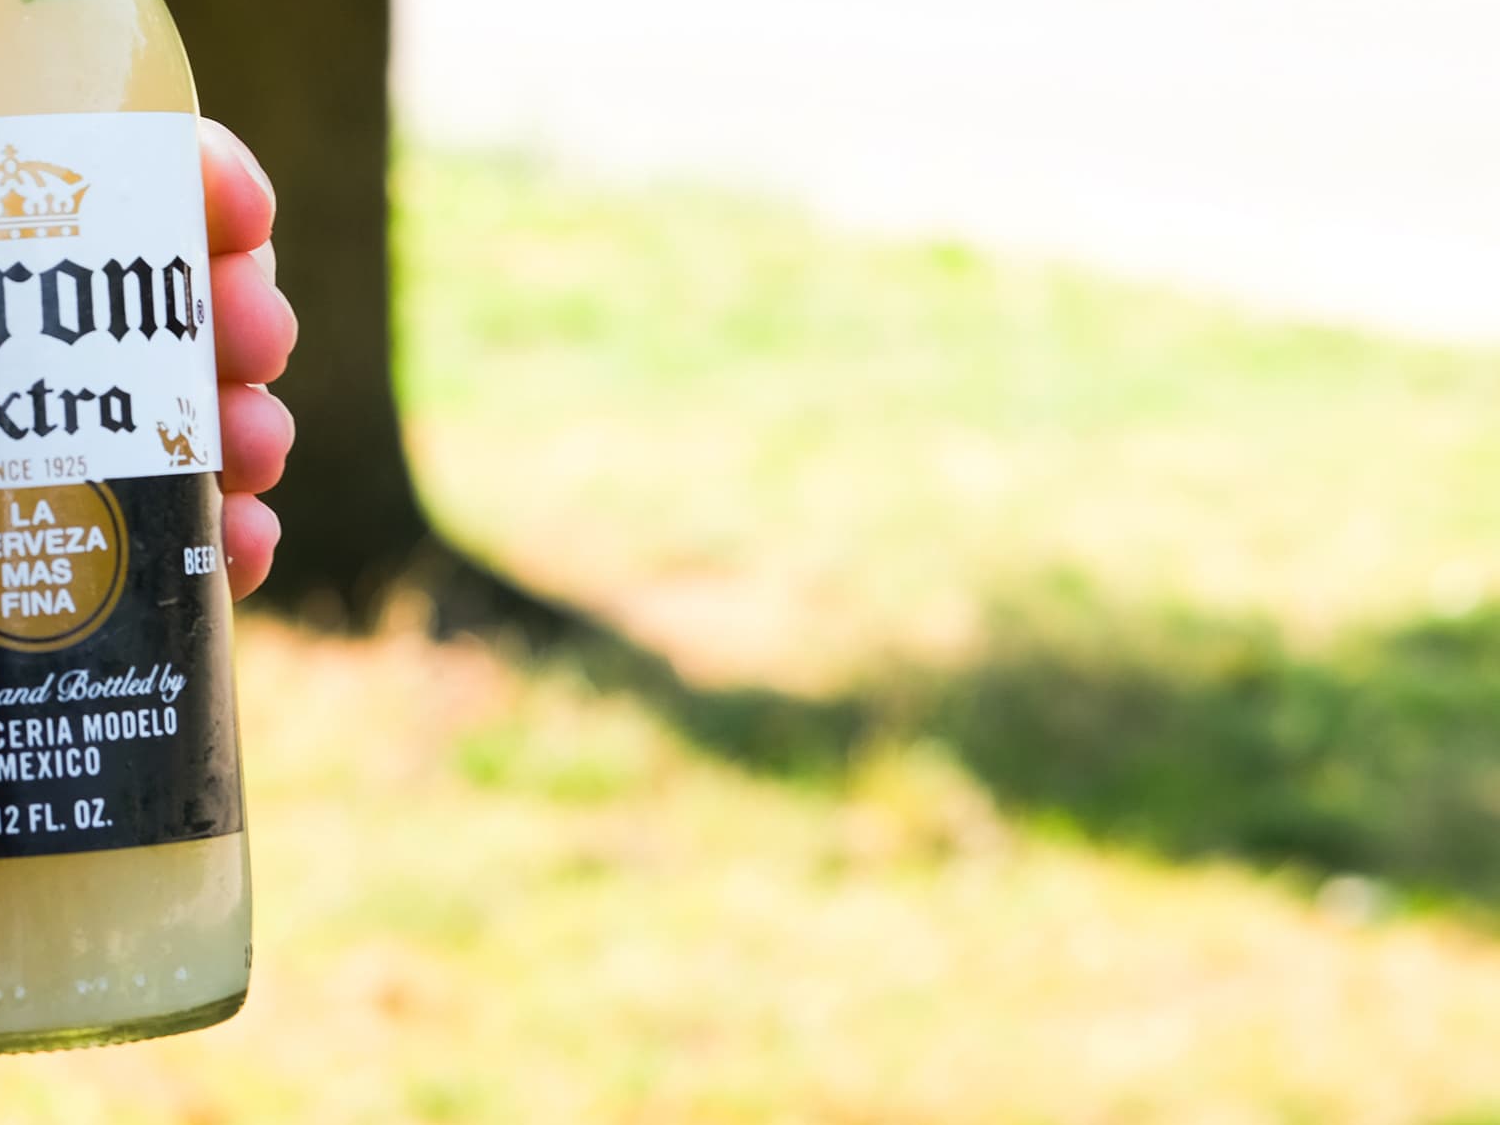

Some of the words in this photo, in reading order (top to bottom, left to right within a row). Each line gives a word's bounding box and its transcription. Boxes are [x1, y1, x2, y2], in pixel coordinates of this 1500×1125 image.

[43, 454, 88, 477] 1925
[10, 499, 55, 527] LA
[1, 558, 73, 588] MAS
[183, 545, 217, 576] BEER
[1, 589, 76, 619] FINA
[56, 666, 159, 703] Bottled
[157, 661, 187, 703] by
[82, 707, 177, 742] MODELO
[28, 803, 66, 834] FL.
[73, 798, 113, 830] OZ.
